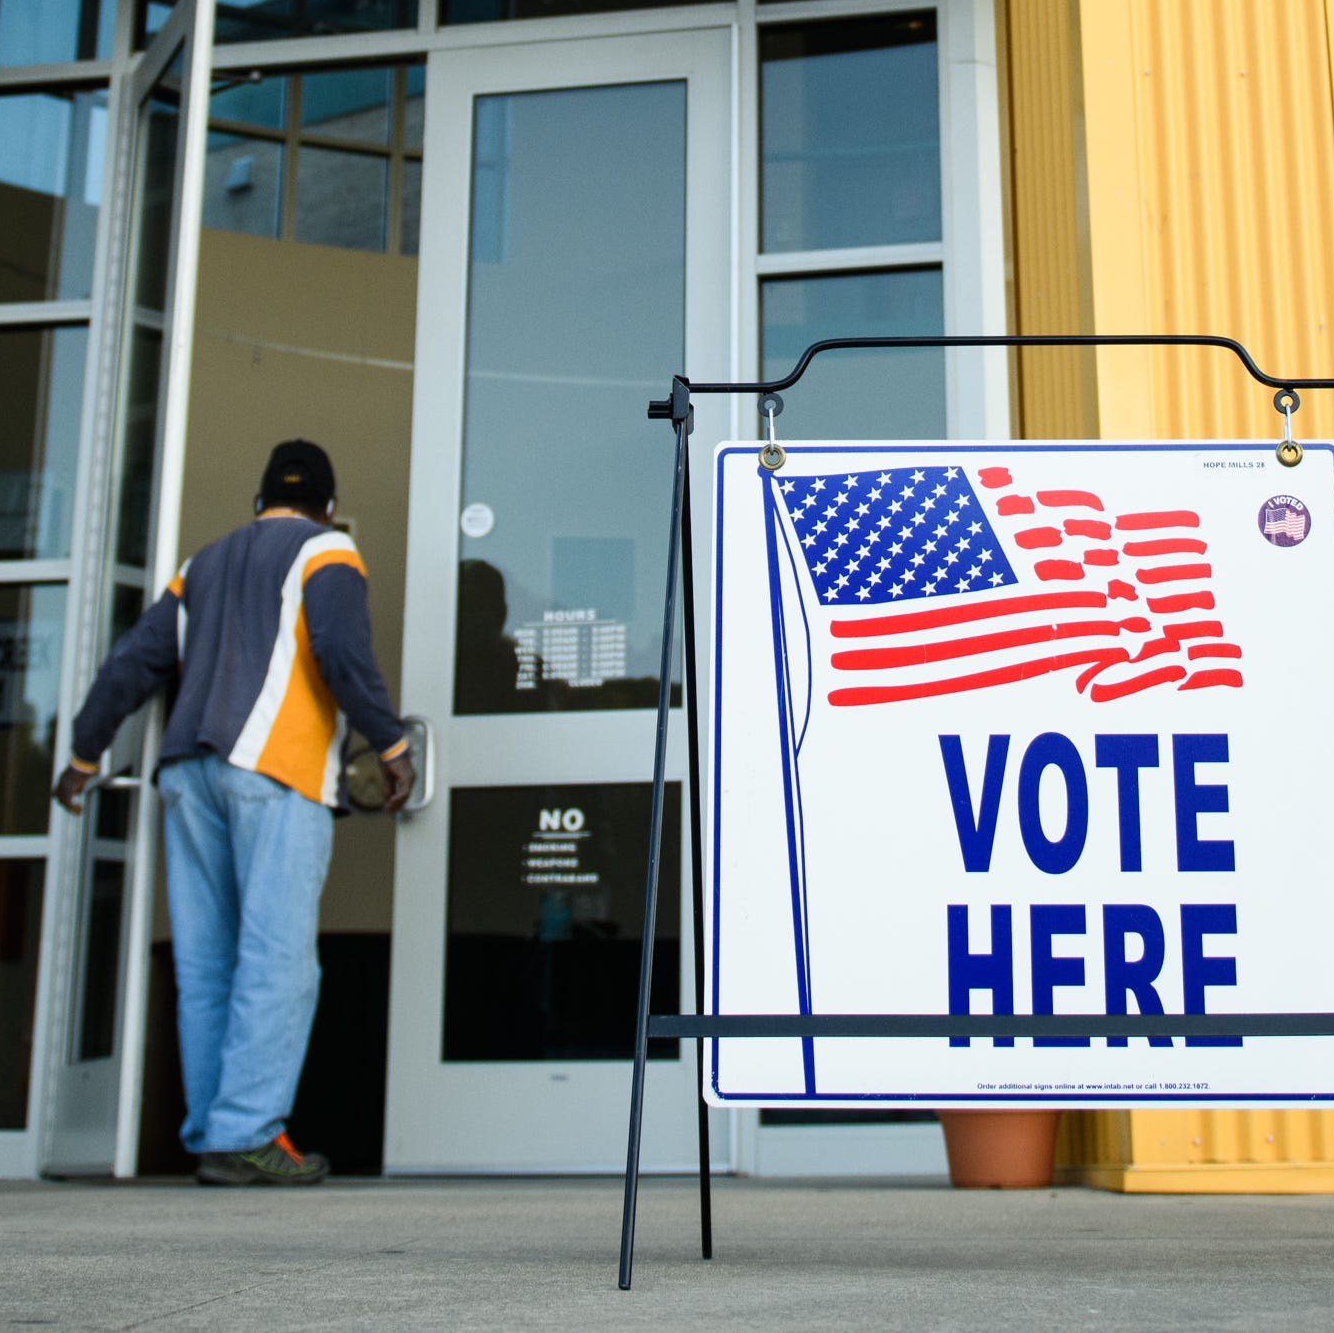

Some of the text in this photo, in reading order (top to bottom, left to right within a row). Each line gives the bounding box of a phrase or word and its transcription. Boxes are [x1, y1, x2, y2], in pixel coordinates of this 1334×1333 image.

[1203, 461, 1226, 469] HOPE
[1228, 461, 1254, 469] MILLS
[1267, 496, 1304, 511] I VOTED
[543, 608, 596, 622] HOURS
[938, 731, 1237, 874] VOTE
[539, 808, 585, 832] NO
[947, 903, 1244, 1048] HERE
[977, 1082, 997, 1090] Order
[998, 1082, 1032, 1090] additional
[1034, 1082, 1053, 1091] signs
[1054, 1082, 1076, 1090] online
[1077, 1082, 1084, 1090] at
[1086, 1082, 1134, 1090] www.intab.net
[1144, 1082, 1157, 1090] call
